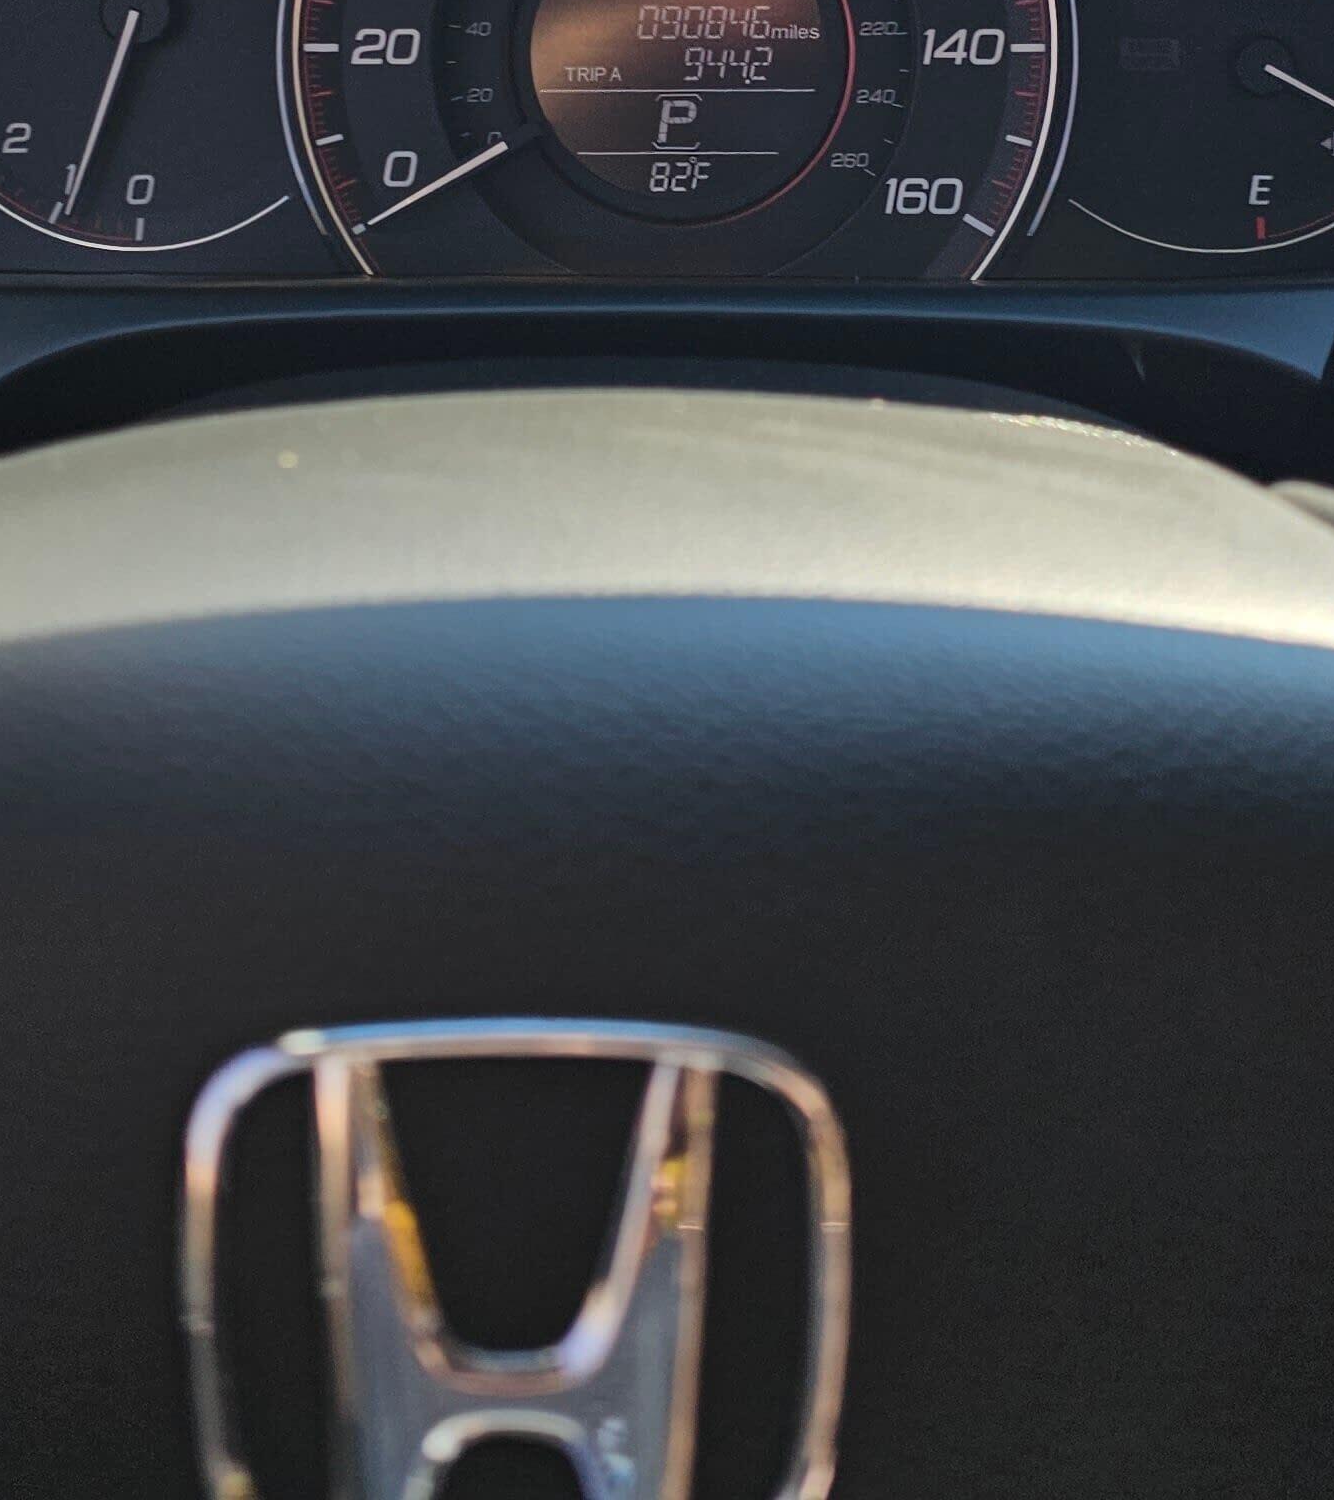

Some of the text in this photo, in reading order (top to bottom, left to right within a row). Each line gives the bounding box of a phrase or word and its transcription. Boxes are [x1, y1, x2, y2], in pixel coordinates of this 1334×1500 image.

[466, 22, 491, 36] 40
[771, 25, 820, 39] miles
[859, 21, 889, 36] 220
[351, 29, 420, 64] 20
[923, 29, 1005, 65] 140
[563, 66, 621, 81] TRIP A
[467, 88, 493, 102] 20
[856, 89, 890, 104] 240
[657, 99, 698, 144] P
[3, 123, 31, 153] 2
[383, 151, 417, 187] 0
[831, 153, 868, 168] 260
[64, 163, 76, 195] 1
[127, 175, 154, 204] 0
[1249, 175, 1273, 204] E
[886, 178, 964, 215] 160
